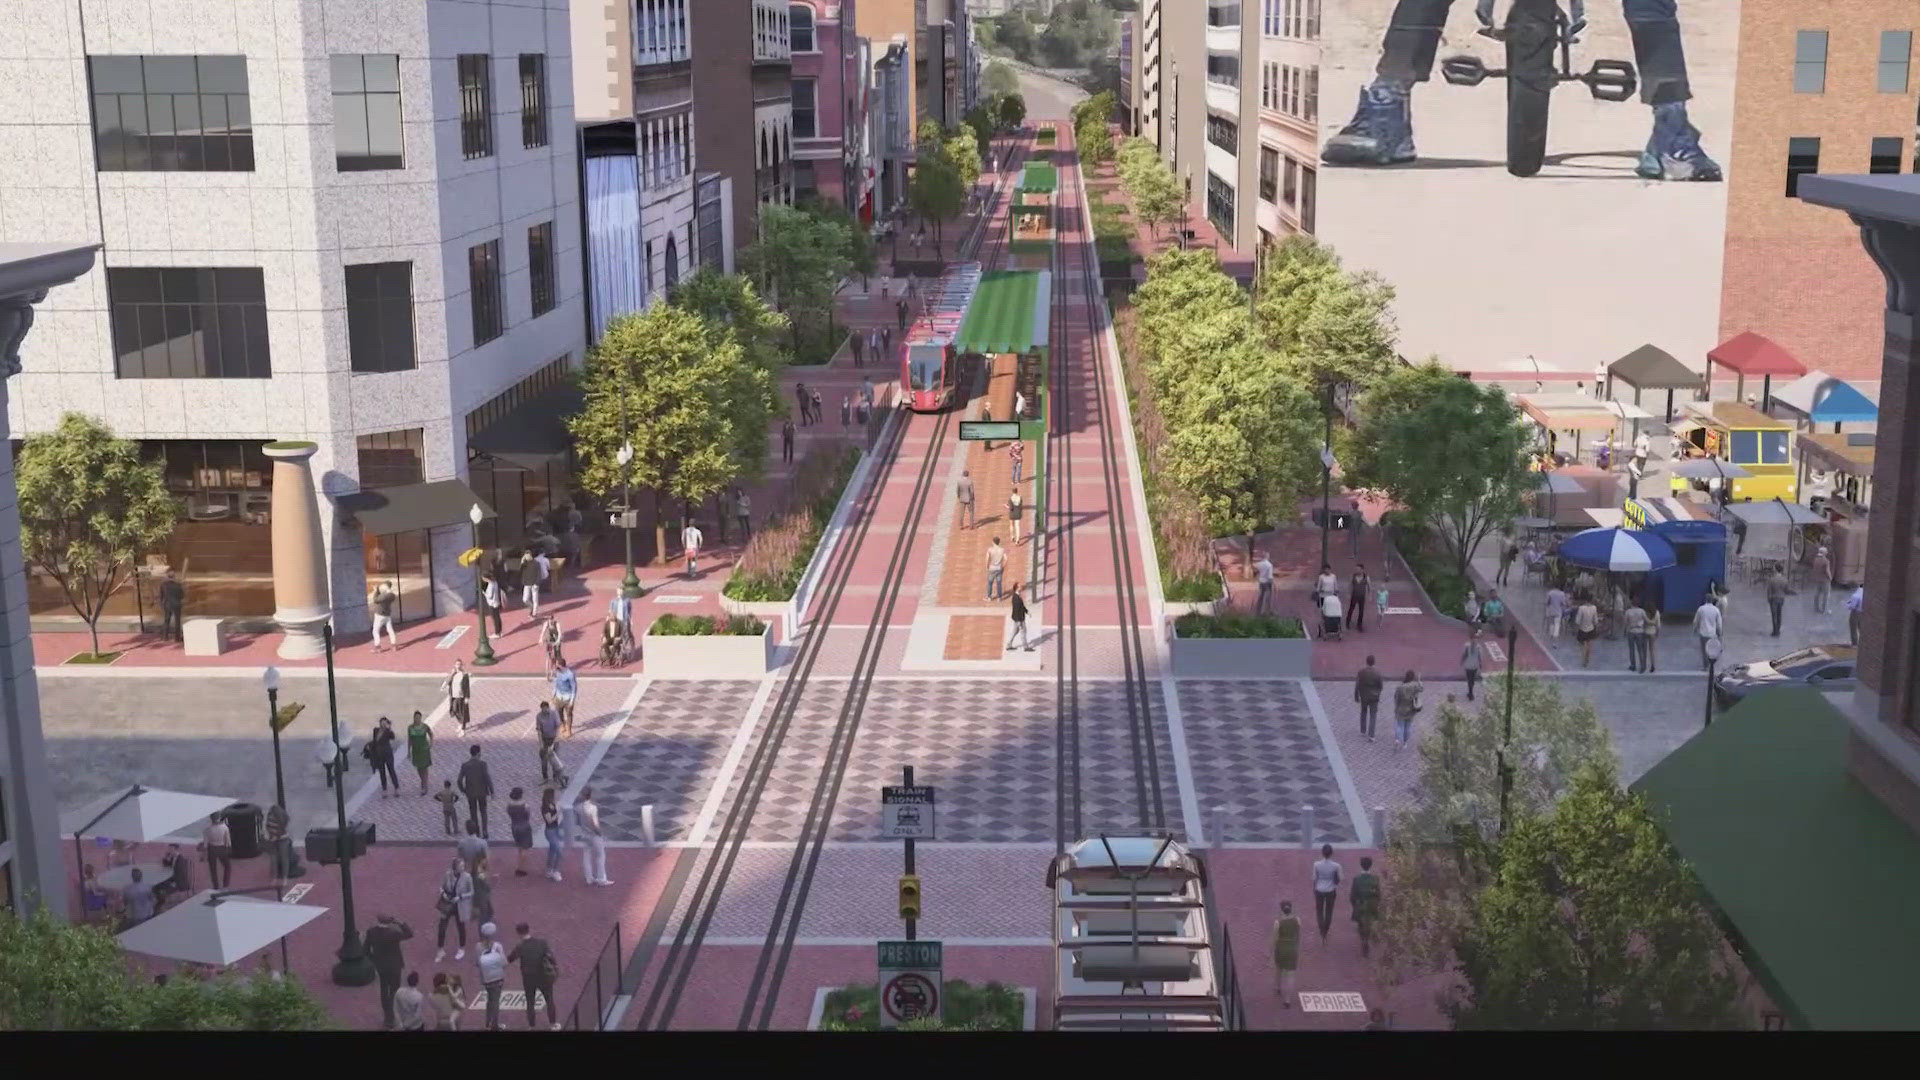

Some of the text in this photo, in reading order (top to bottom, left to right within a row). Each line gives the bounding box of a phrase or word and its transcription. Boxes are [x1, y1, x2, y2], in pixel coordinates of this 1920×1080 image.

[891, 787, 927, 795] TRAIN
[886, 796, 929, 805] SIGNAL
[893, 827, 924, 836] ONLY
[879, 944, 941, 963] PRESTON
[1301, 994, 1364, 1010] PRAIRIE
